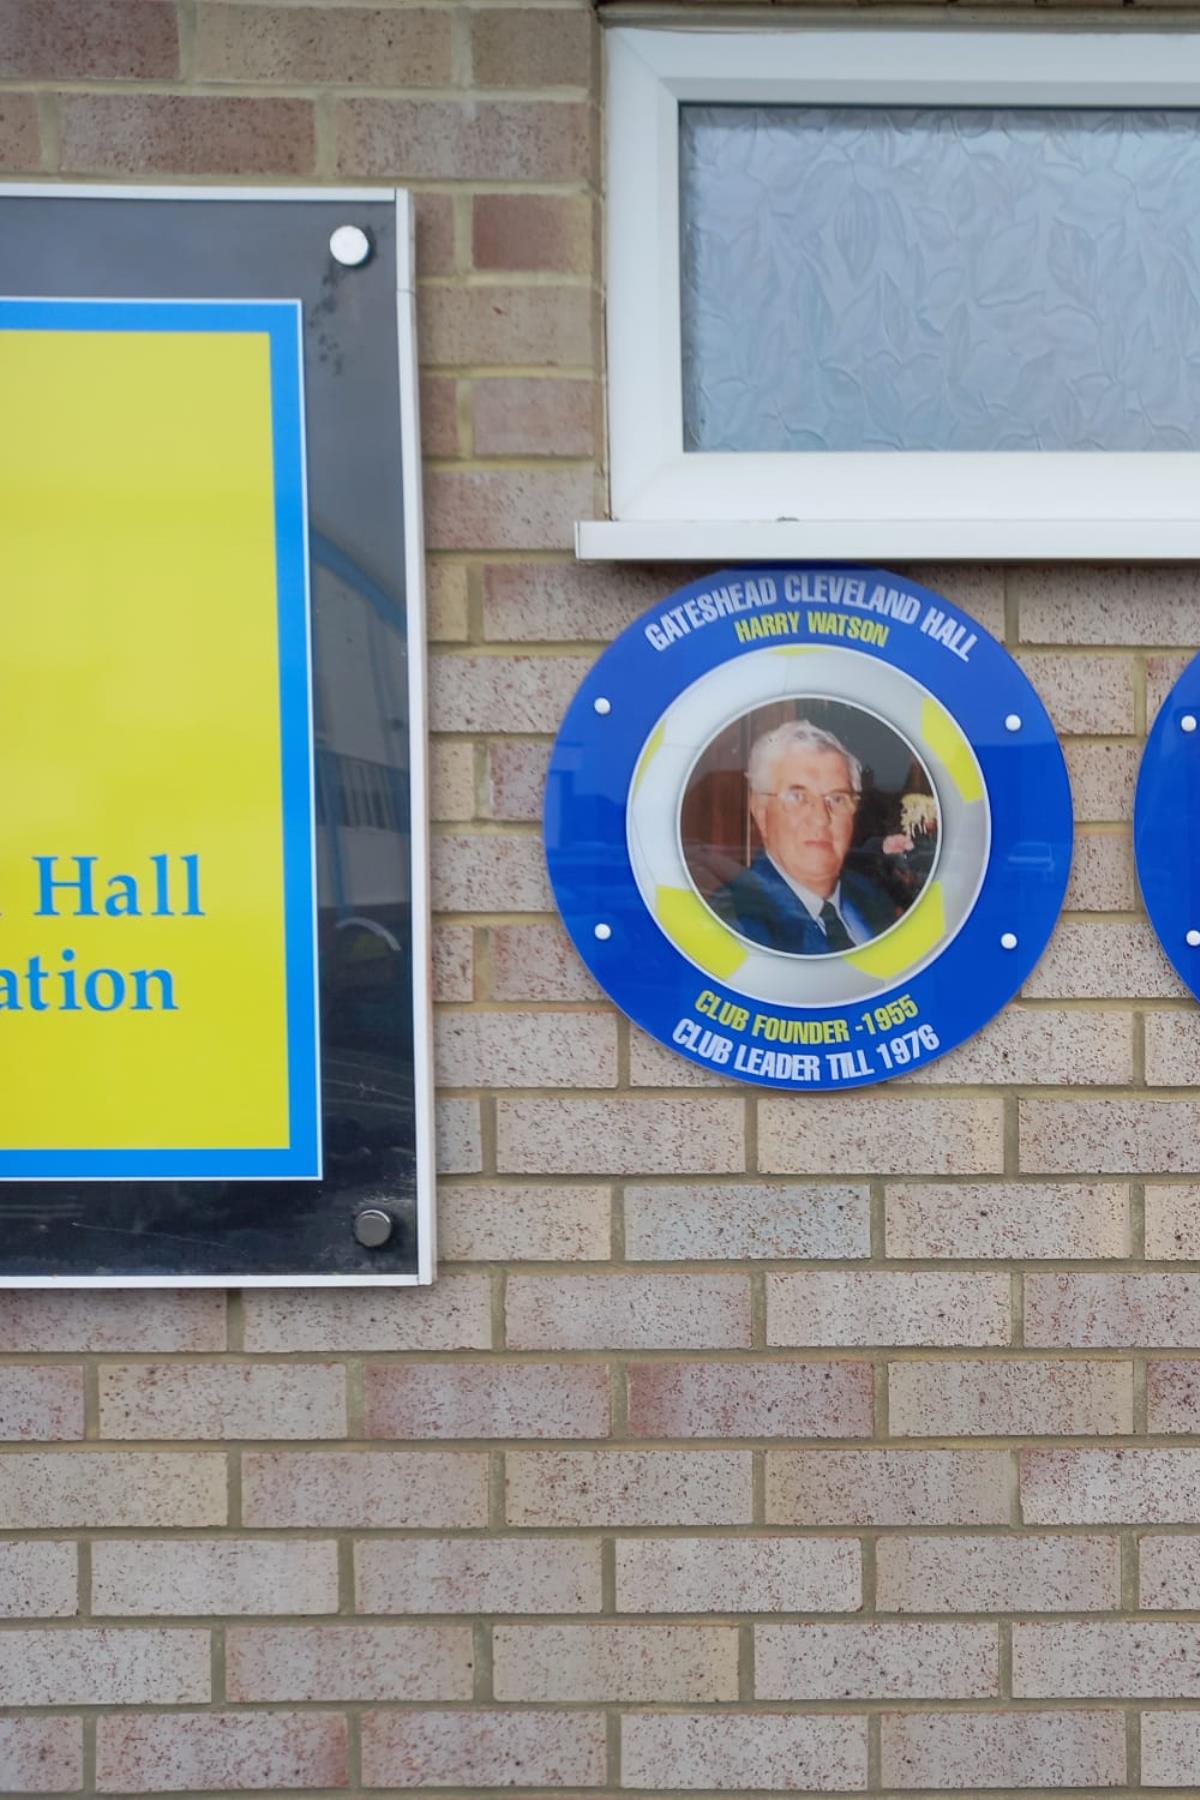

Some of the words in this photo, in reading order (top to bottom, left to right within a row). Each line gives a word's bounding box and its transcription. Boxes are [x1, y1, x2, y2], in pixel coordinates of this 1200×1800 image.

[644, 578, 777, 651] GATESHEAD
[784, 577, 921, 625] CLEVELAND
[922, 607, 978, 662] HALL
[734, 611, 800, 643] HARRY
[807, 611, 890, 648] WATSON
[31, 854, 206, 917] Hall
[695, 990, 750, 1032] CLUB
[752, 1015, 850, 1045] FOUNDER
[672, 1018, 734, 1065] CLUB
[734, 1046, 821, 1081] LEADER
[826, 1050, 875, 1080] TILL
[876, 1024, 940, 1069] 1976
